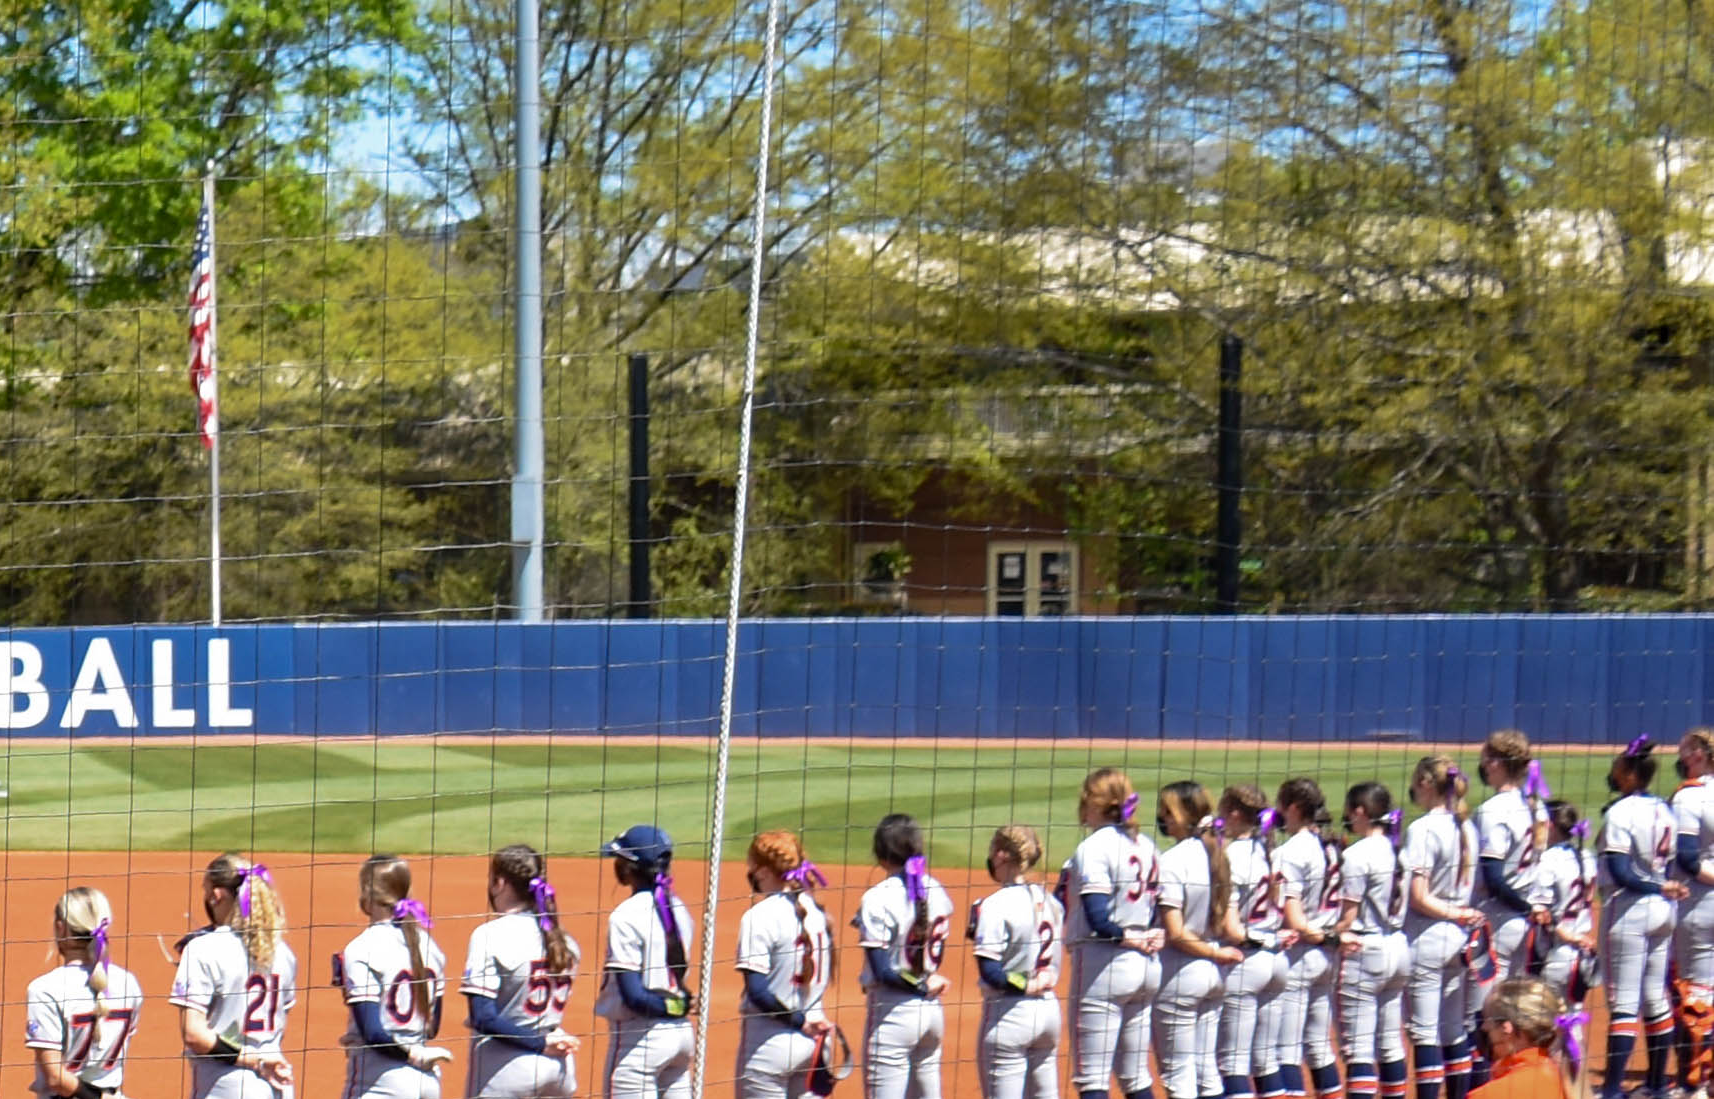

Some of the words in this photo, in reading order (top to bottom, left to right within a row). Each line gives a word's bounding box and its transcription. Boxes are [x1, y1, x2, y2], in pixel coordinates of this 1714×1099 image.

[1035, 920, 1054, 970] 2
[243, 973, 280, 1034] 21
[65, 1007, 134, 1072] 77
